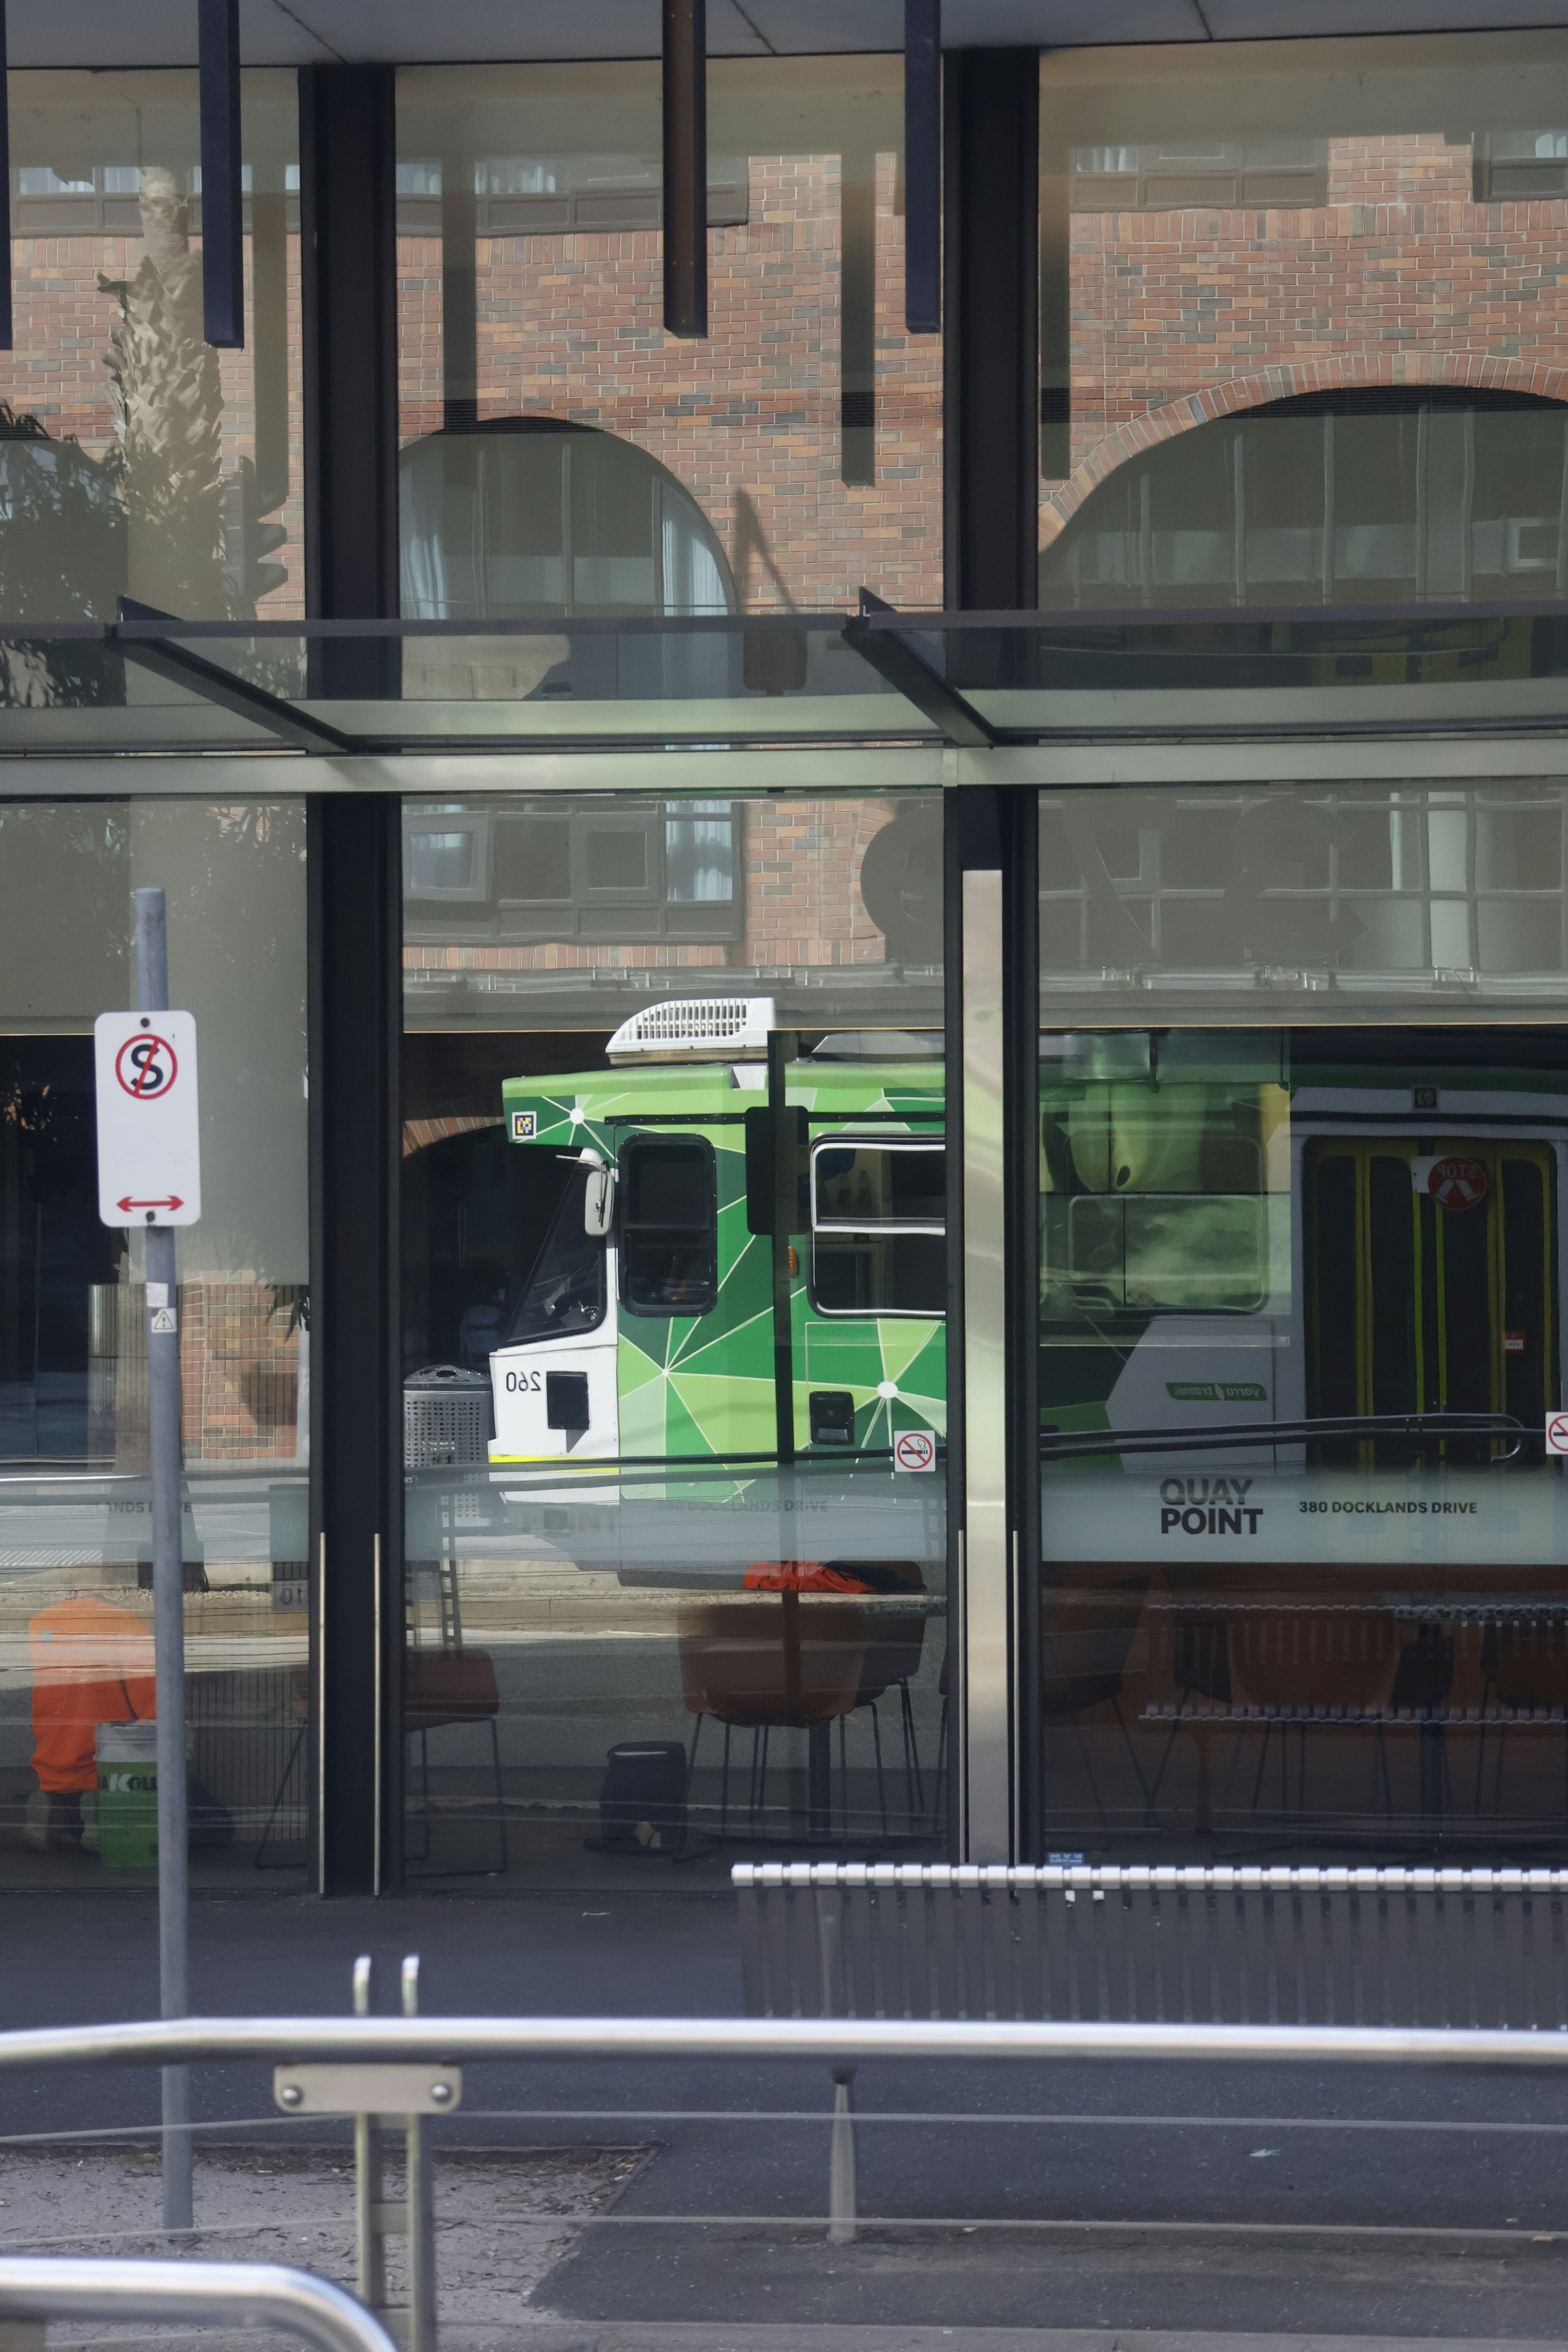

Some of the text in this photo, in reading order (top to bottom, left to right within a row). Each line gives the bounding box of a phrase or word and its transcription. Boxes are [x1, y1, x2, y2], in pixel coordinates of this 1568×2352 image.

[131, 1044, 164, 1090] S
[1160, 1478, 1252, 1505] QUAY
[784, 1500, 828, 1512] DRIVE
[1299, 1502, 1477, 1514] 380 DOCKLANDS DRIVE
[1161, 1508, 1263, 1534] POINT
